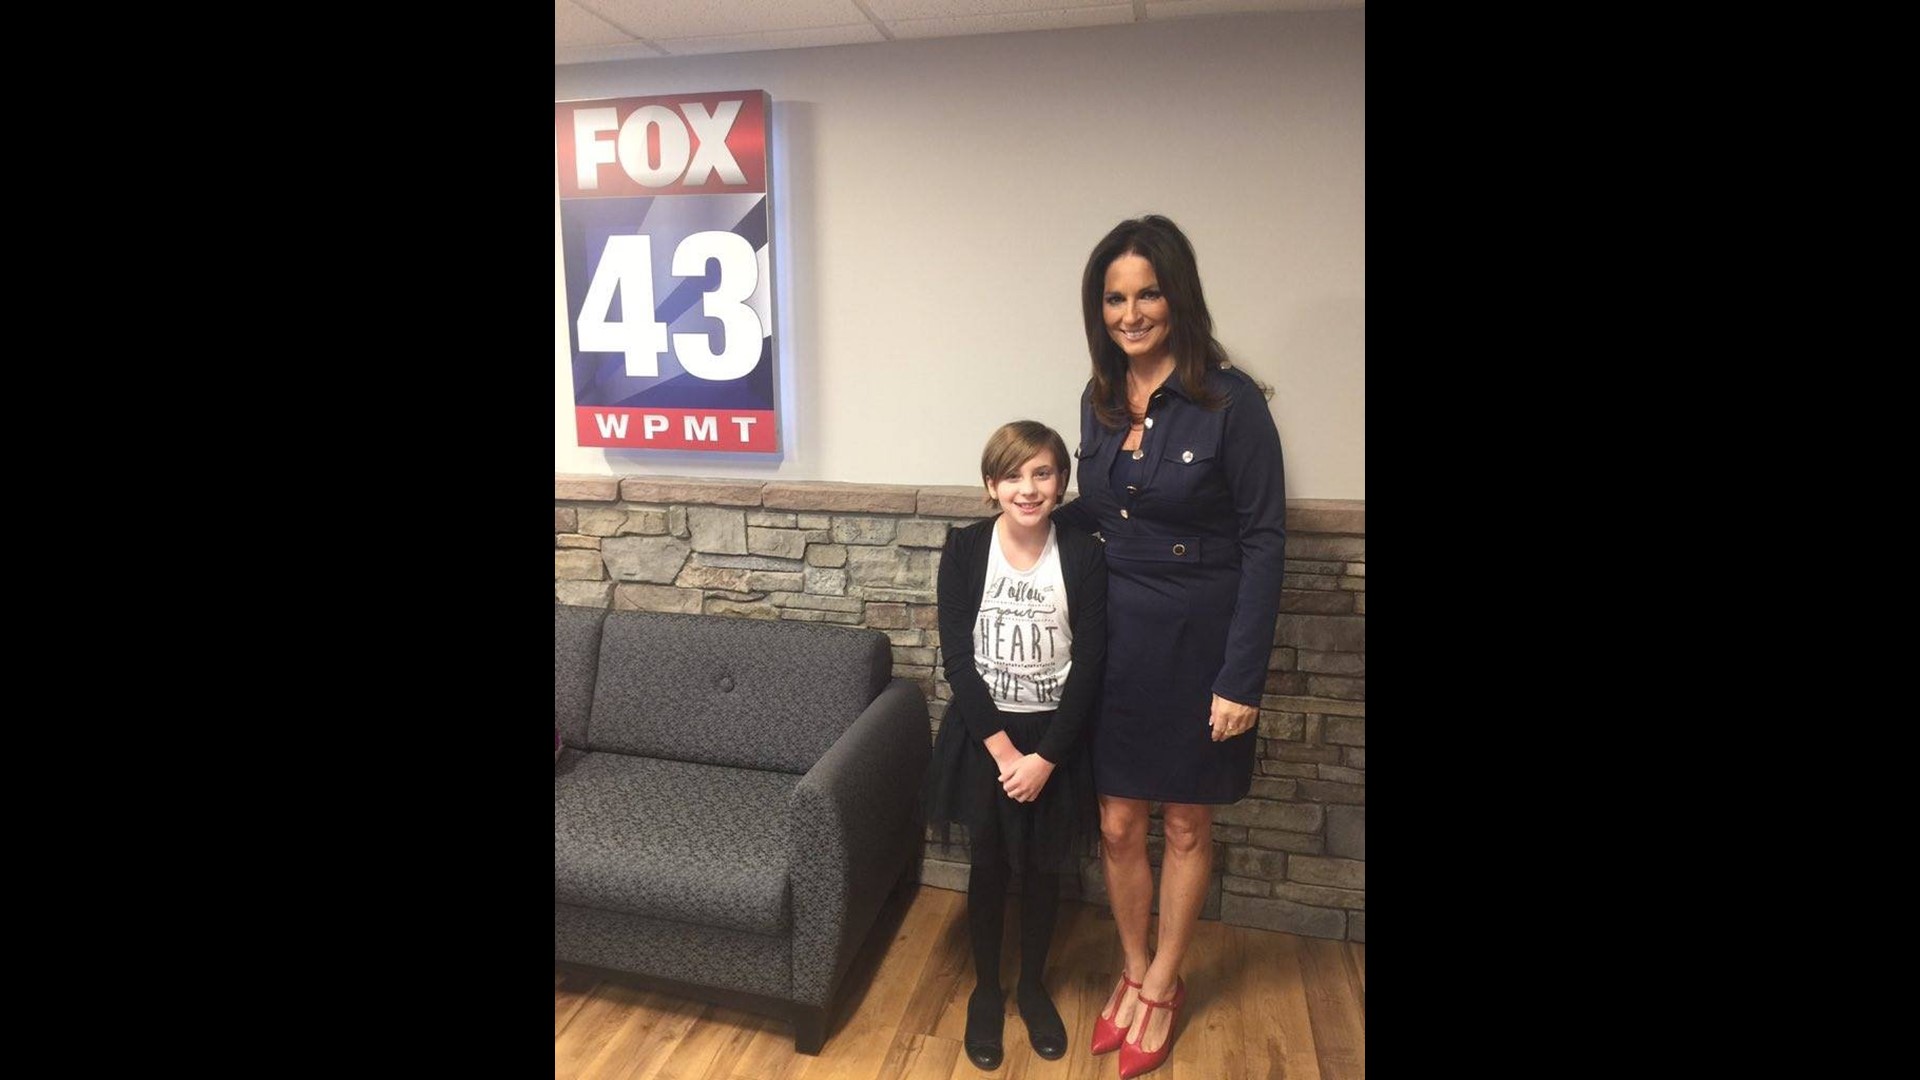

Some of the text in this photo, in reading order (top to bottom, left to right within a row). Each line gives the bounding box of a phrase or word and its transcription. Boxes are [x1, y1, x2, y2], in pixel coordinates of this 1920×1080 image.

[573, 100, 748, 189] FOX
[577, 230, 763, 381] 43
[594, 413, 757, 442] WPMT
[986, 577, 1046, 603] Follow
[980, 606, 1056, 626] your
[980, 618, 1058, 662] HEART
[984, 667, 1024, 702] IVE
